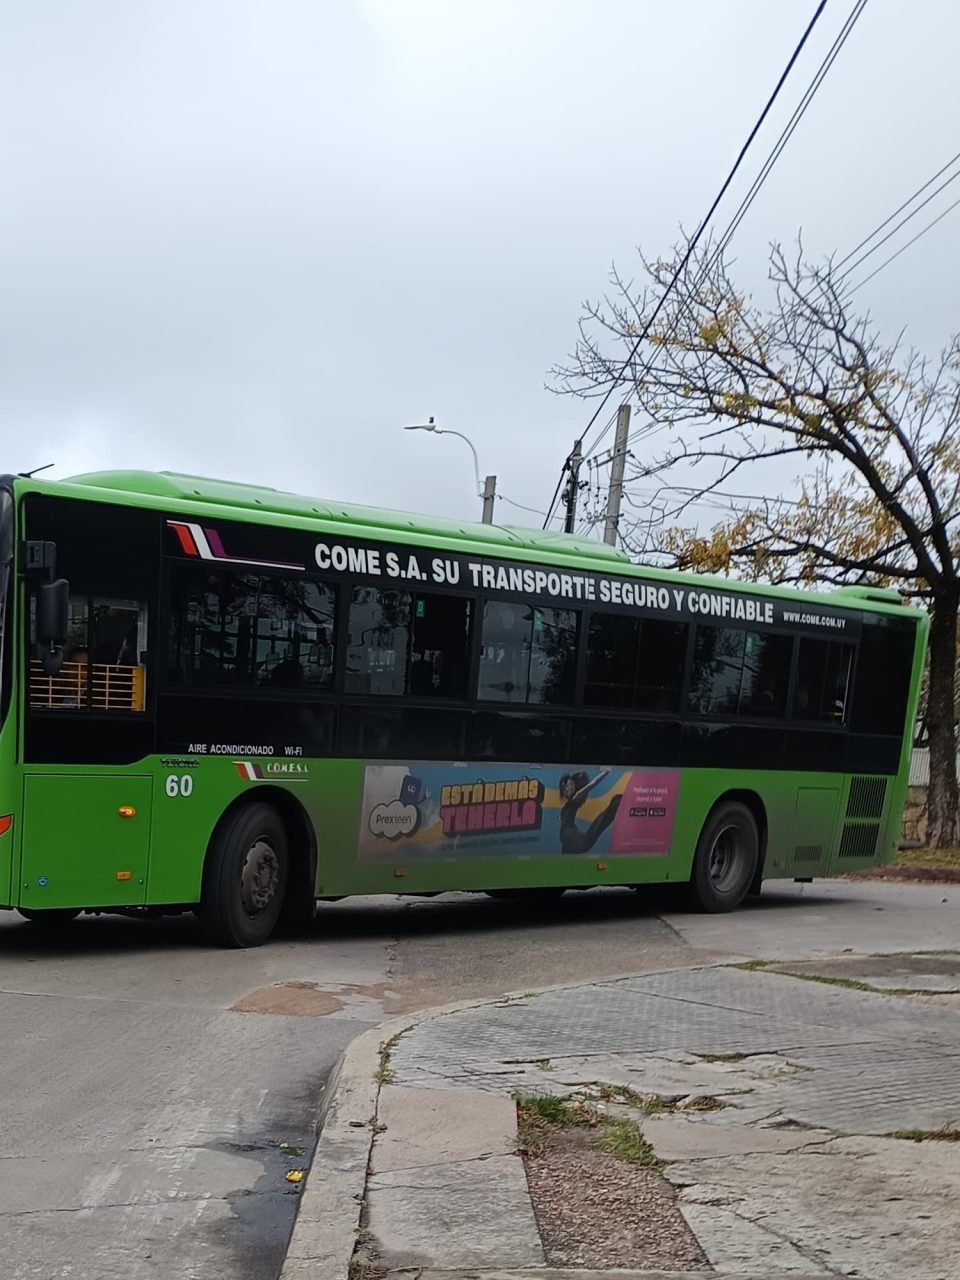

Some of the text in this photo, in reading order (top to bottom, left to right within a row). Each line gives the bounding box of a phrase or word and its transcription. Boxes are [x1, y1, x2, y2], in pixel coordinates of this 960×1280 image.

[315, 543, 774, 624] COME S.A. SU TRANSPORTE SEGURO Y CONFIABLE
[783, 611, 846, 629] WWW.COME.COM.UY
[188, 744, 274, 755] AIRE ACONDICIONADO
[284, 746, 302, 756] Wi-Fi
[165, 774, 193, 797] 60
[484, 775, 539, 802] DEMÁS
